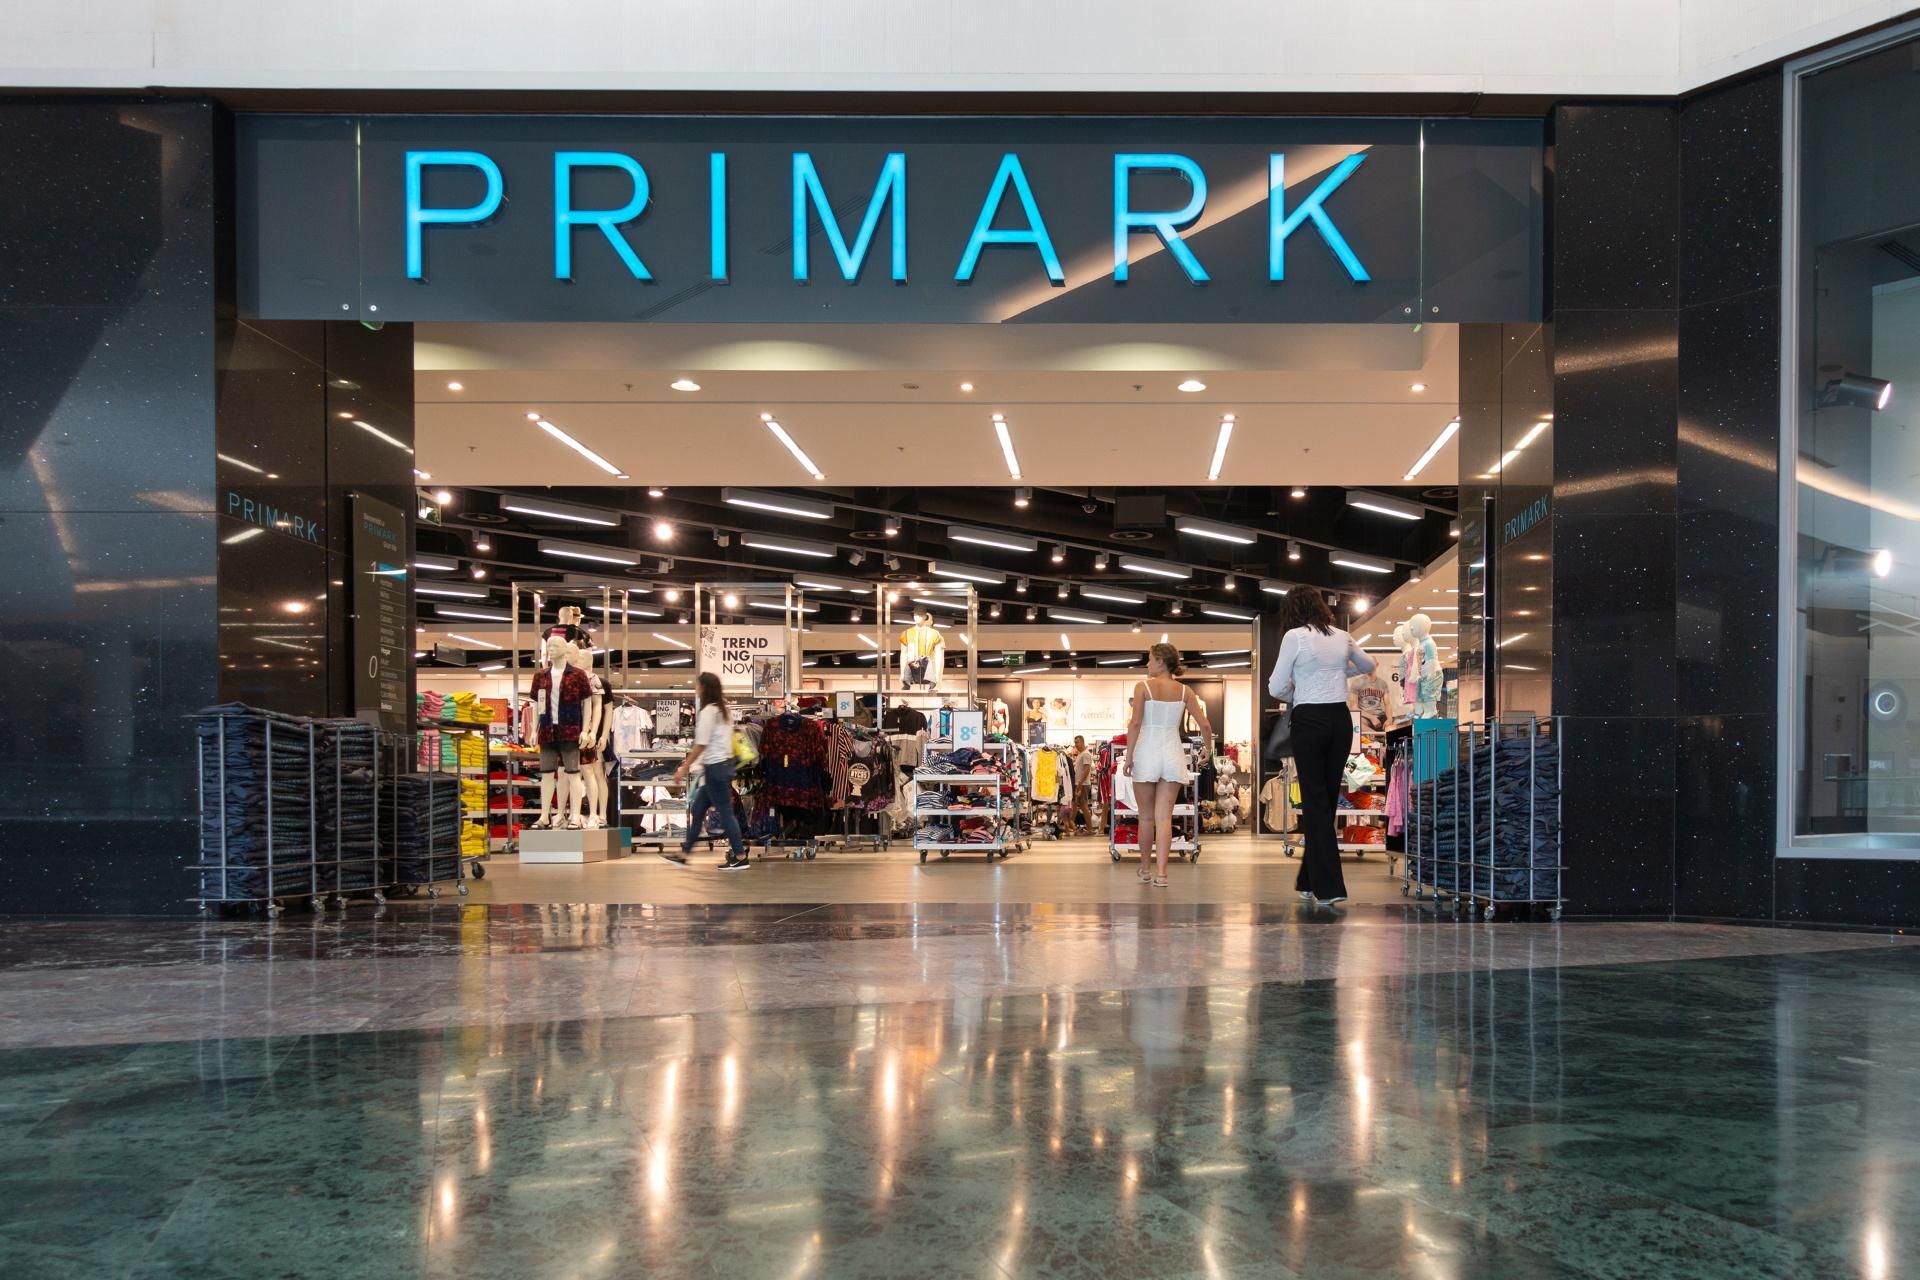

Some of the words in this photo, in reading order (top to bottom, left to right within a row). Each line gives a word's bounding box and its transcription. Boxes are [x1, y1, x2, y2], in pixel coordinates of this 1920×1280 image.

[403, 151, 1371, 284] PRIMARK
[228, 492, 317, 543] PRIMARK
[1504, 493, 1548, 544] PRIMARK
[721, 637, 769, 649] TREND
[722, 650, 750, 662] ING
[960, 726, 977, 741] 8€
